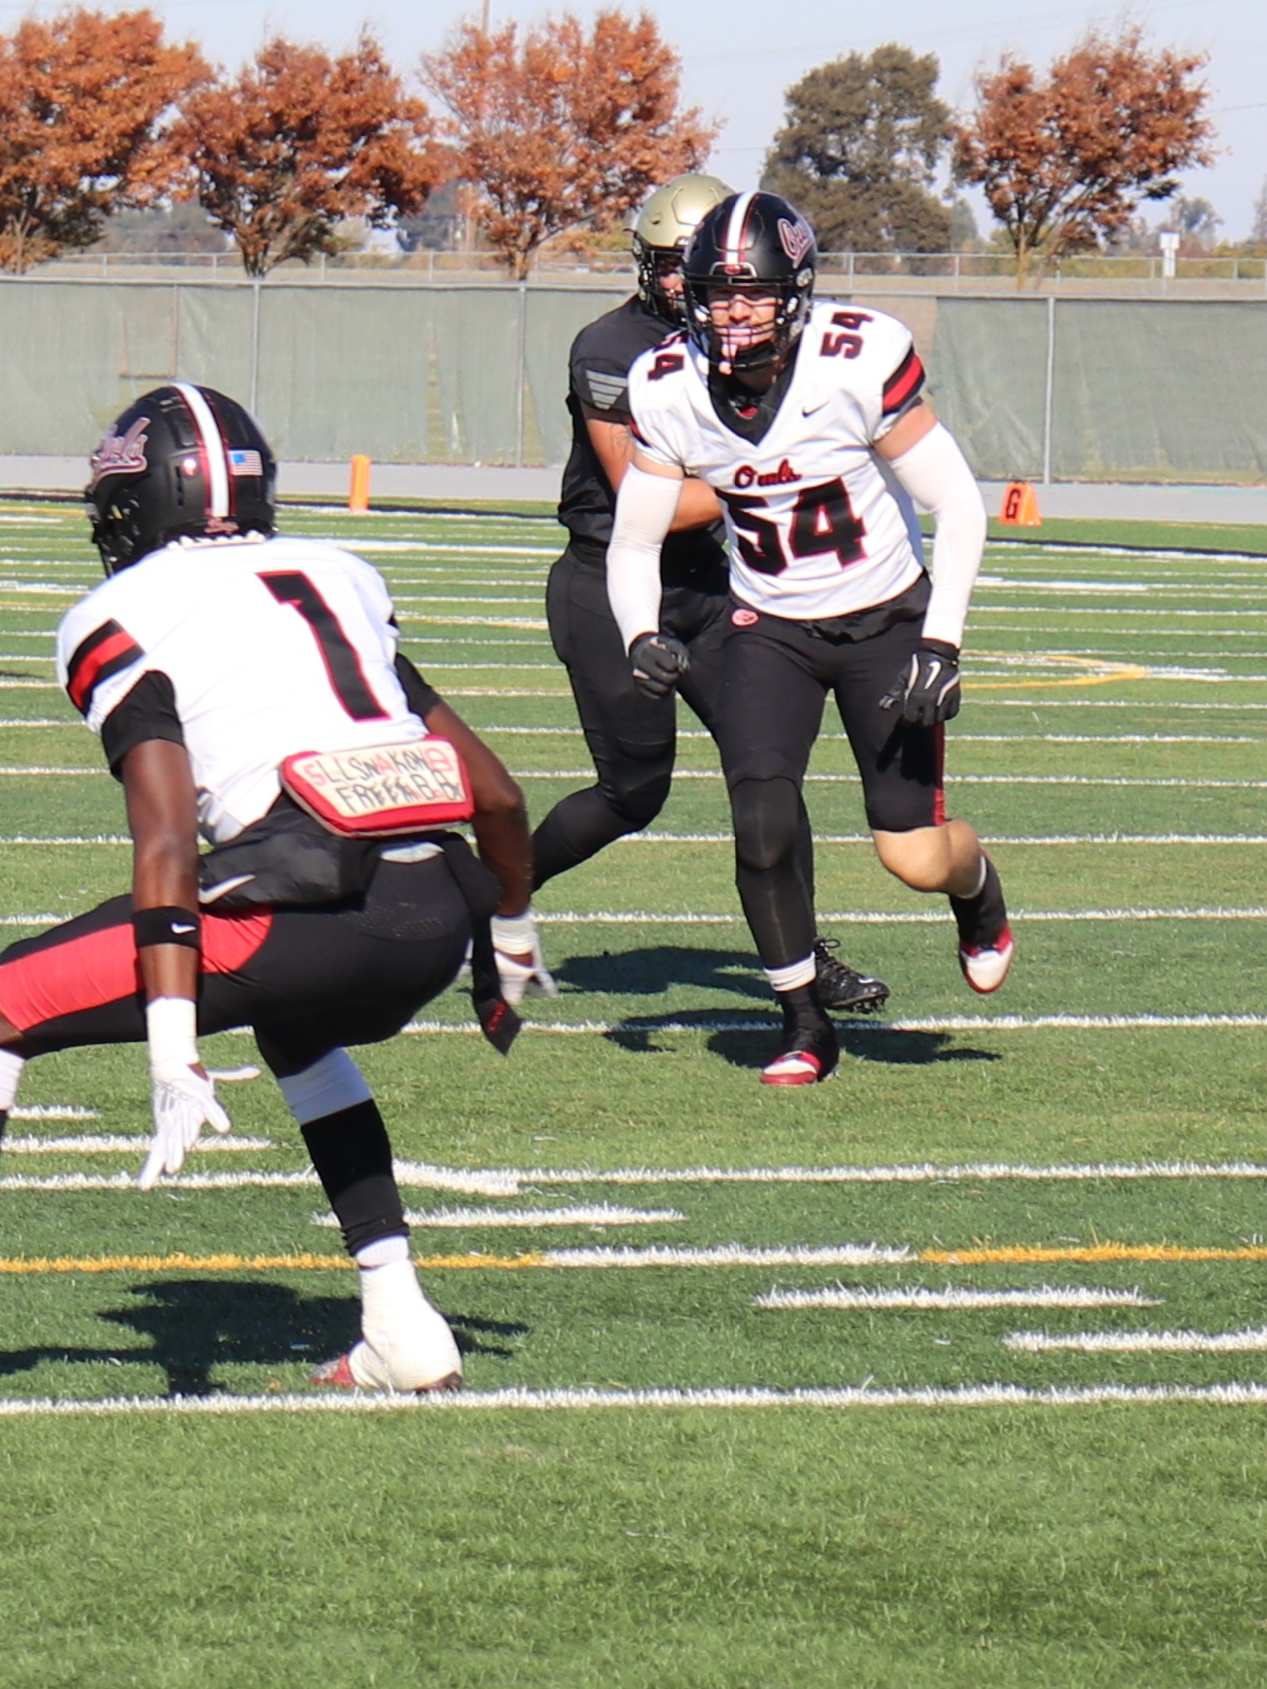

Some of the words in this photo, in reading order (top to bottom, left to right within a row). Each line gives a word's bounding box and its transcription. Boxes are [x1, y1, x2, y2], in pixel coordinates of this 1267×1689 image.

[819, 311, 874, 359] 54
[714, 476, 868, 577] 54
[1006, 488, 1021, 519] G
[255, 570, 392, 723] 1
